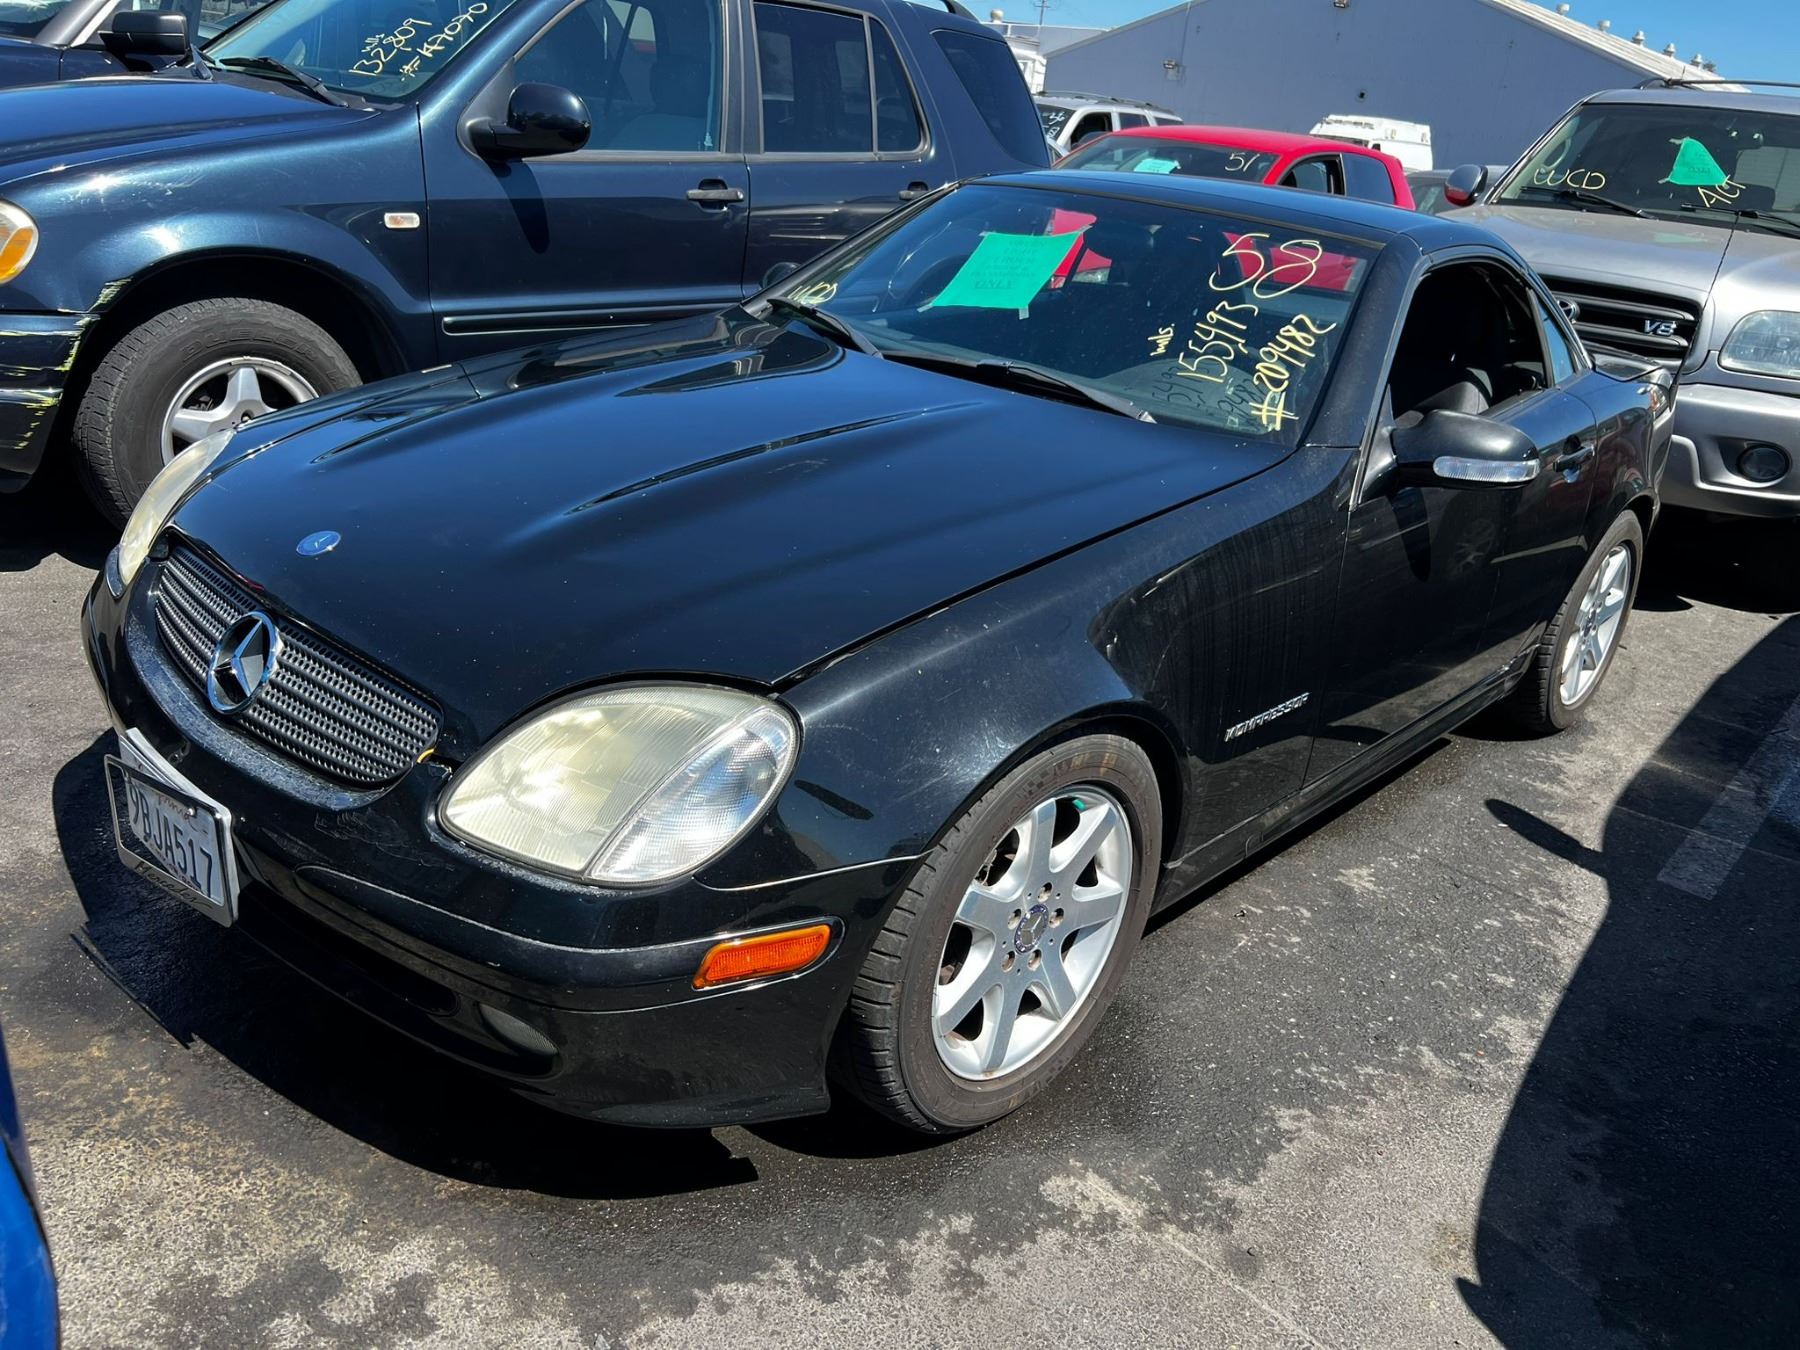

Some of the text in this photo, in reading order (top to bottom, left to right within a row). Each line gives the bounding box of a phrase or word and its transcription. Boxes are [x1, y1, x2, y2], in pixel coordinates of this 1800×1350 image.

[1533, 168, 1606, 190] WCD
[1208, 233, 1322, 299] 58
[1644, 319, 1678, 336] V8
[128, 782, 213, 900] 9BJA517
